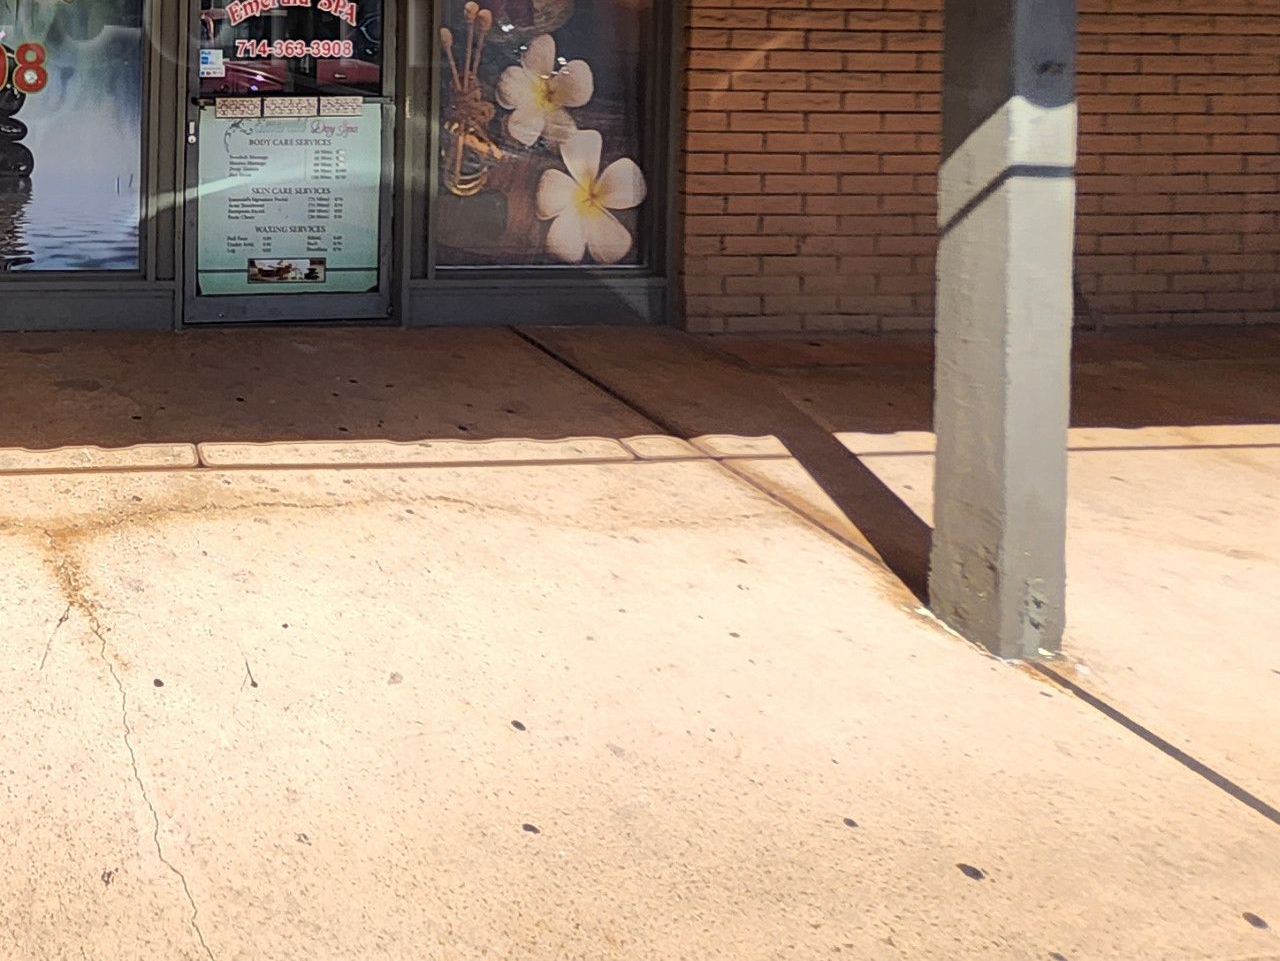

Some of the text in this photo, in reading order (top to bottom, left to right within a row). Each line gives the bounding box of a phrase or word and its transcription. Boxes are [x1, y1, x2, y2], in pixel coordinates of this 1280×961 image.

[235, 40, 354, 58] 714-363-3908
[249, 139, 332, 147] BODY CARE SERVICES
[251, 187, 331, 196] SKIN CARE SERVICES
[255, 225, 326, 234] WAXING SERVICES
